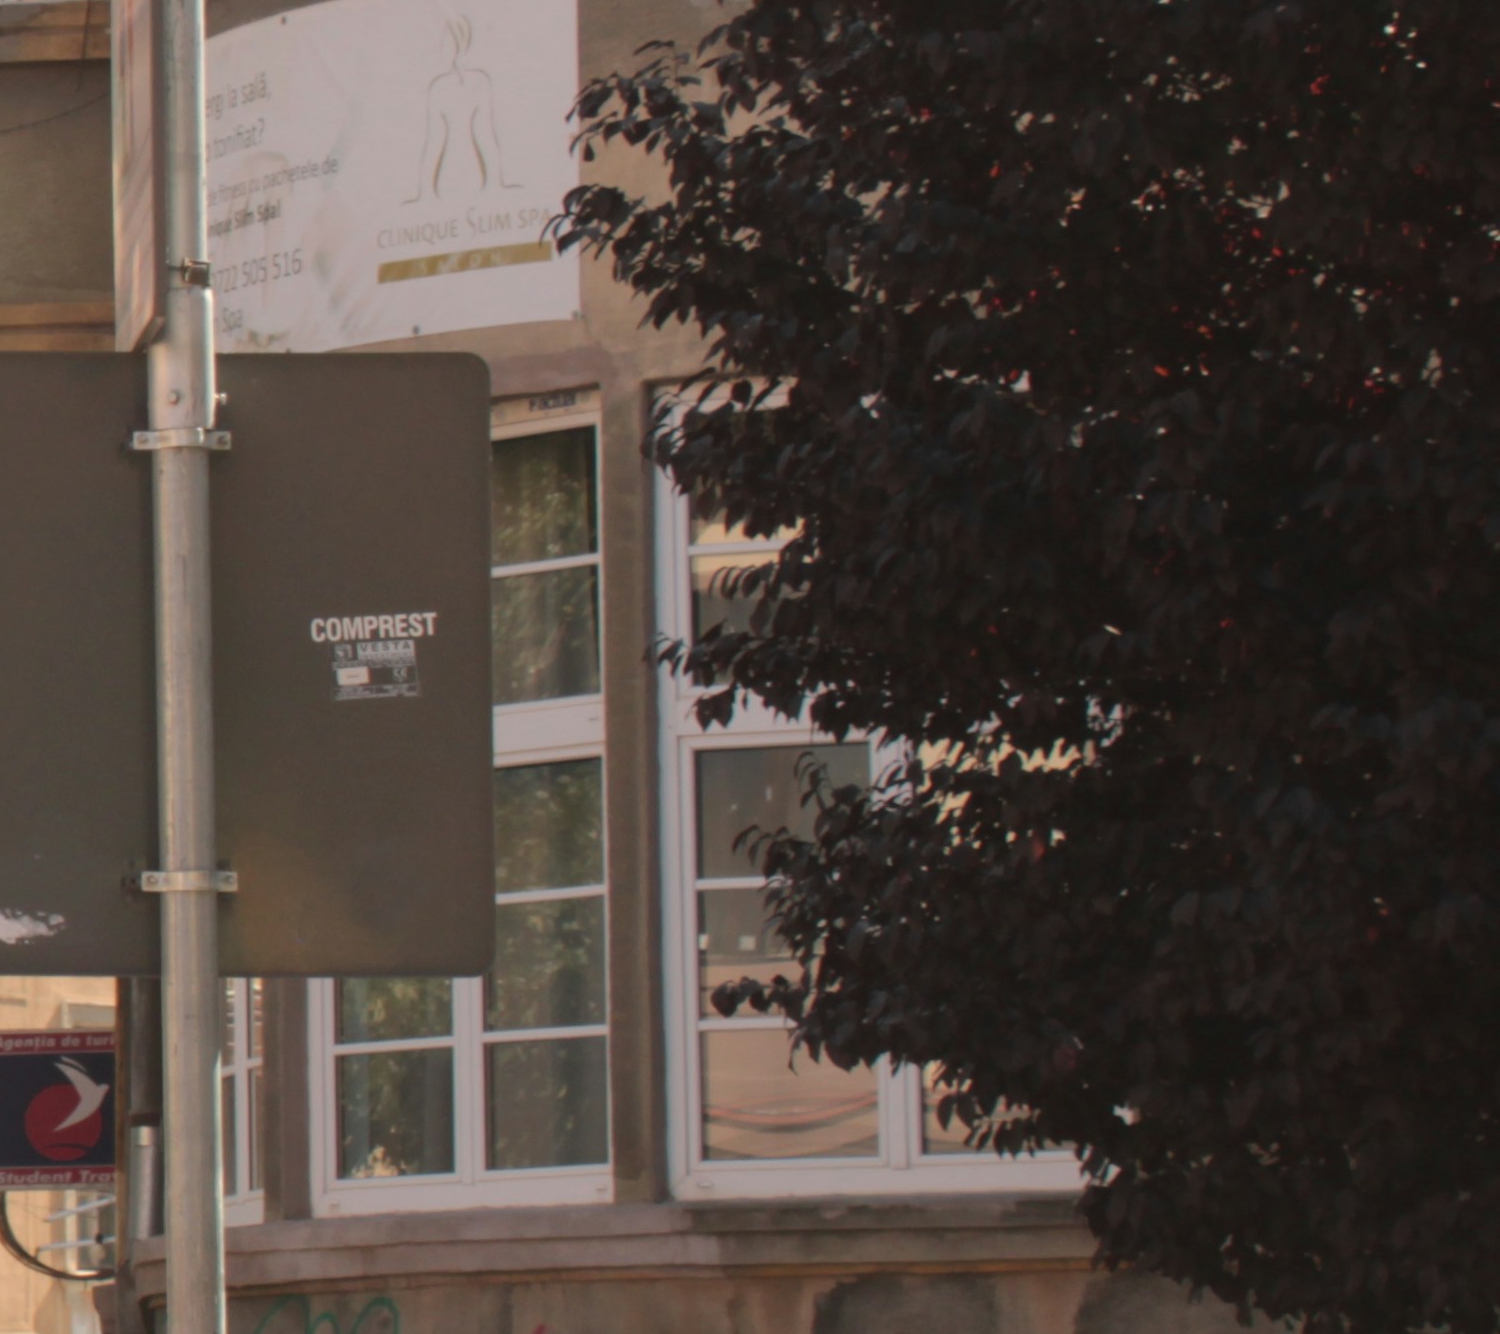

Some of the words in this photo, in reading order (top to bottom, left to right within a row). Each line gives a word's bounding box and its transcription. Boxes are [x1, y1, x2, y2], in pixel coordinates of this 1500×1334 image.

[376, 218, 460, 250] CLINIQUE
[241, 257, 269, 288] 505
[272, 247, 303, 280] 516
[310, 612, 438, 643] COMPREST
[361, 642, 413, 652] VESTA
[61, 1035, 81, 1047] de
